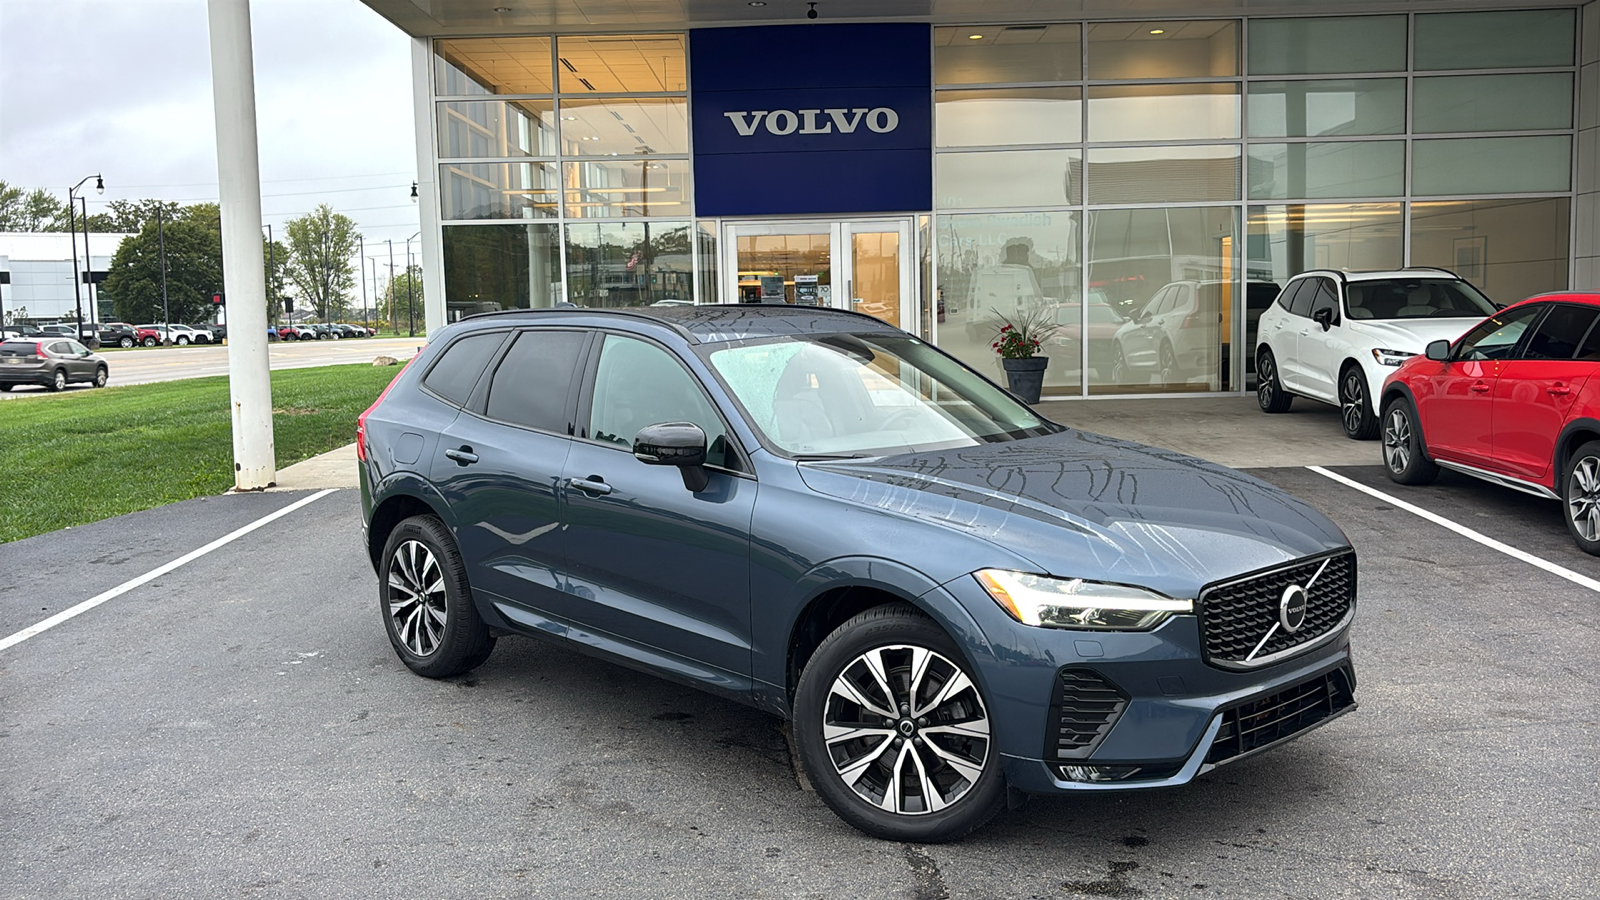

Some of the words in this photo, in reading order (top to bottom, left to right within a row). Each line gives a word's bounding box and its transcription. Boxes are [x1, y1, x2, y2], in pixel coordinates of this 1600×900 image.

[724, 107, 899, 136] VOLVO
[987, 213, 1052, 227] Swedish
[938, 234, 973, 247] Cars
[979, 232, 1008, 246] LLC
[1288, 605, 1305, 614] VOLVO
